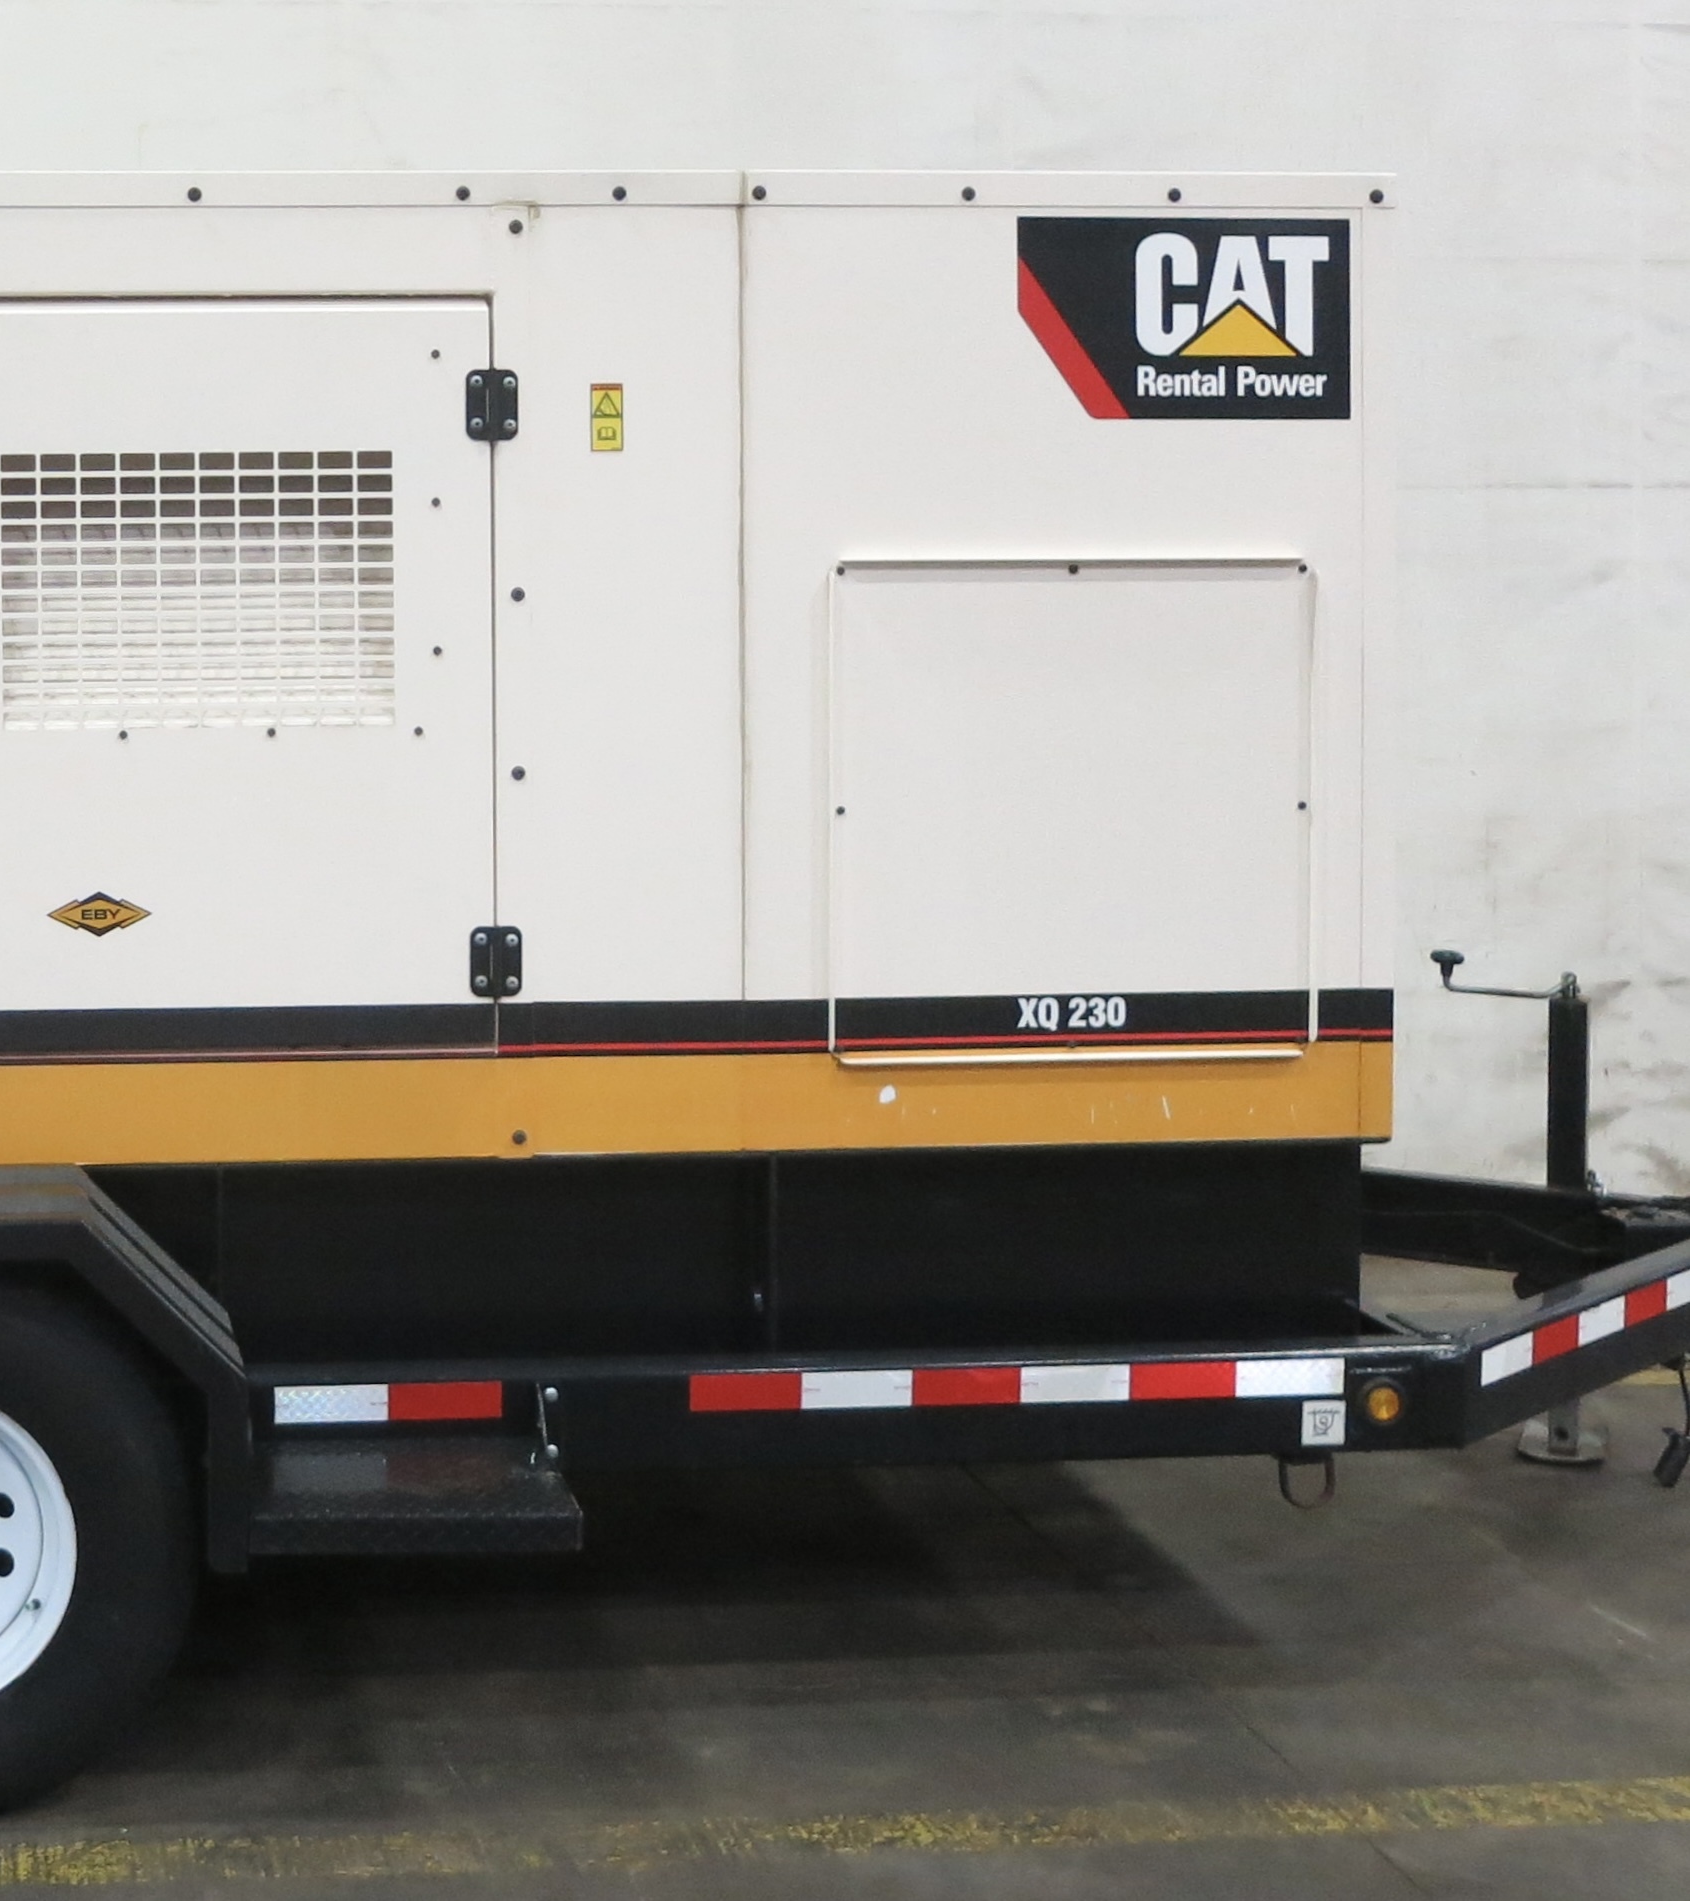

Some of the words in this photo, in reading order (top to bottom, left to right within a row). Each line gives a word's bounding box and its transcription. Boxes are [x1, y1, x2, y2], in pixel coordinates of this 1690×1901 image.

[1135, 232, 1329, 357] CAT
[1137, 365, 1225, 397] Rental
[1237, 365, 1327, 398] Power
[81, 908, 121, 920] EBY
[1016, 996, 1059, 1031] XQ
[1067, 995, 1127, 1028] 230
